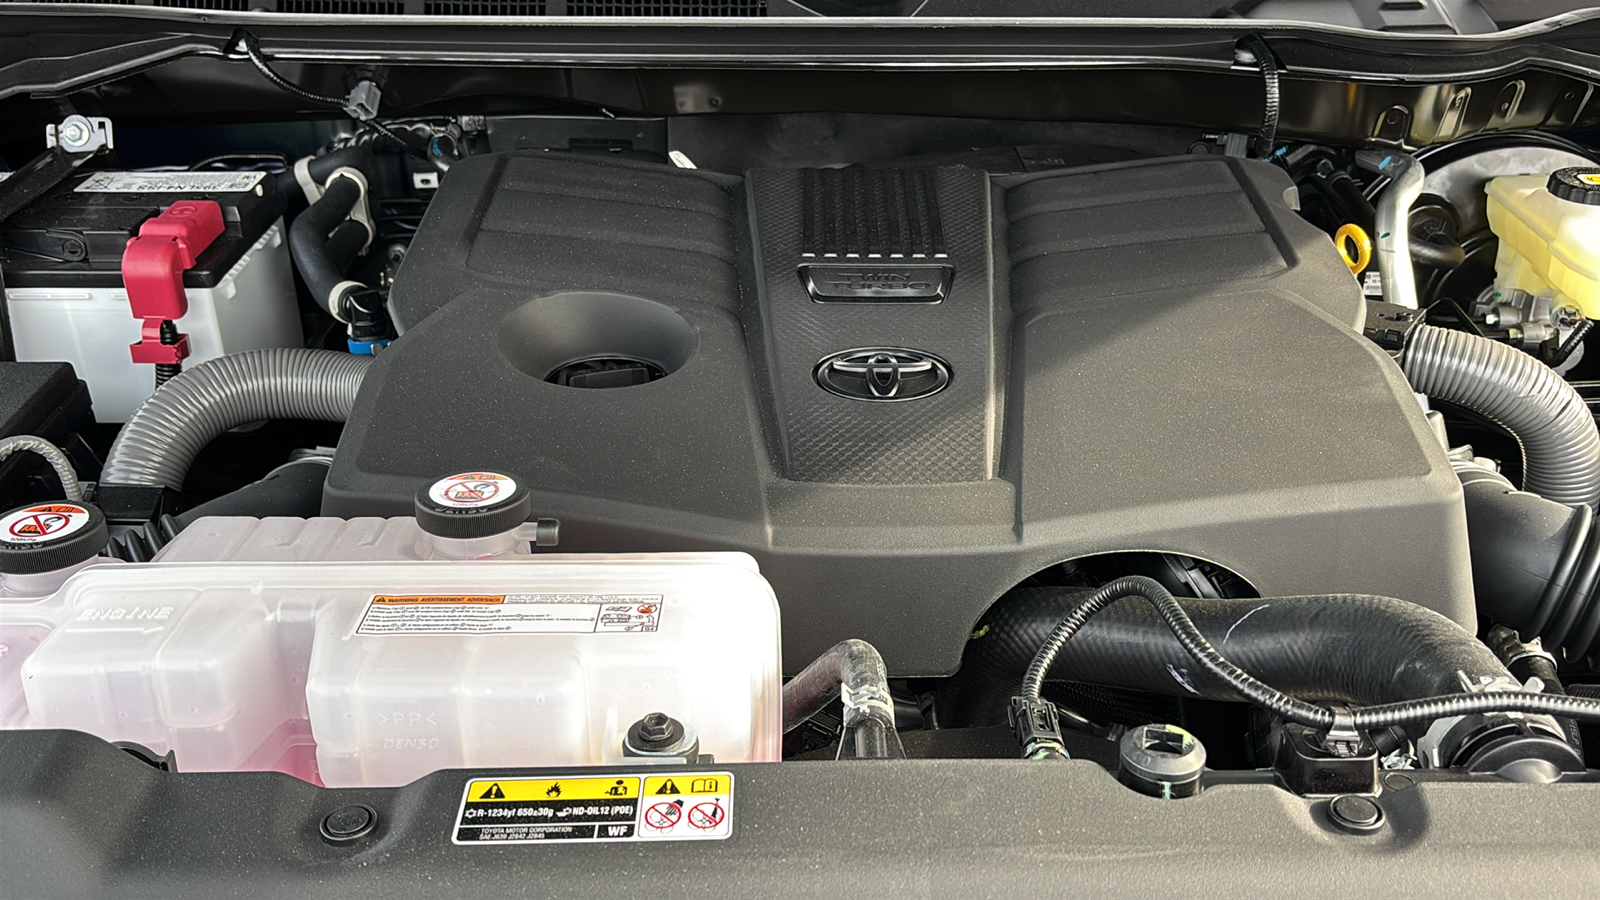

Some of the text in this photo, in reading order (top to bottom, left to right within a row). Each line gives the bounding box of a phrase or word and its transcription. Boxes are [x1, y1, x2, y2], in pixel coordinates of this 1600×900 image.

[824, 281, 930, 290] TURBO
[76, 606, 174, 621] ENGINE
[383, 738, 440, 749] DENSO
[477, 805, 634, 819] R-1234yf 650±30g ND-OIL12 (POE)
[607, 826, 628, 836] WF
